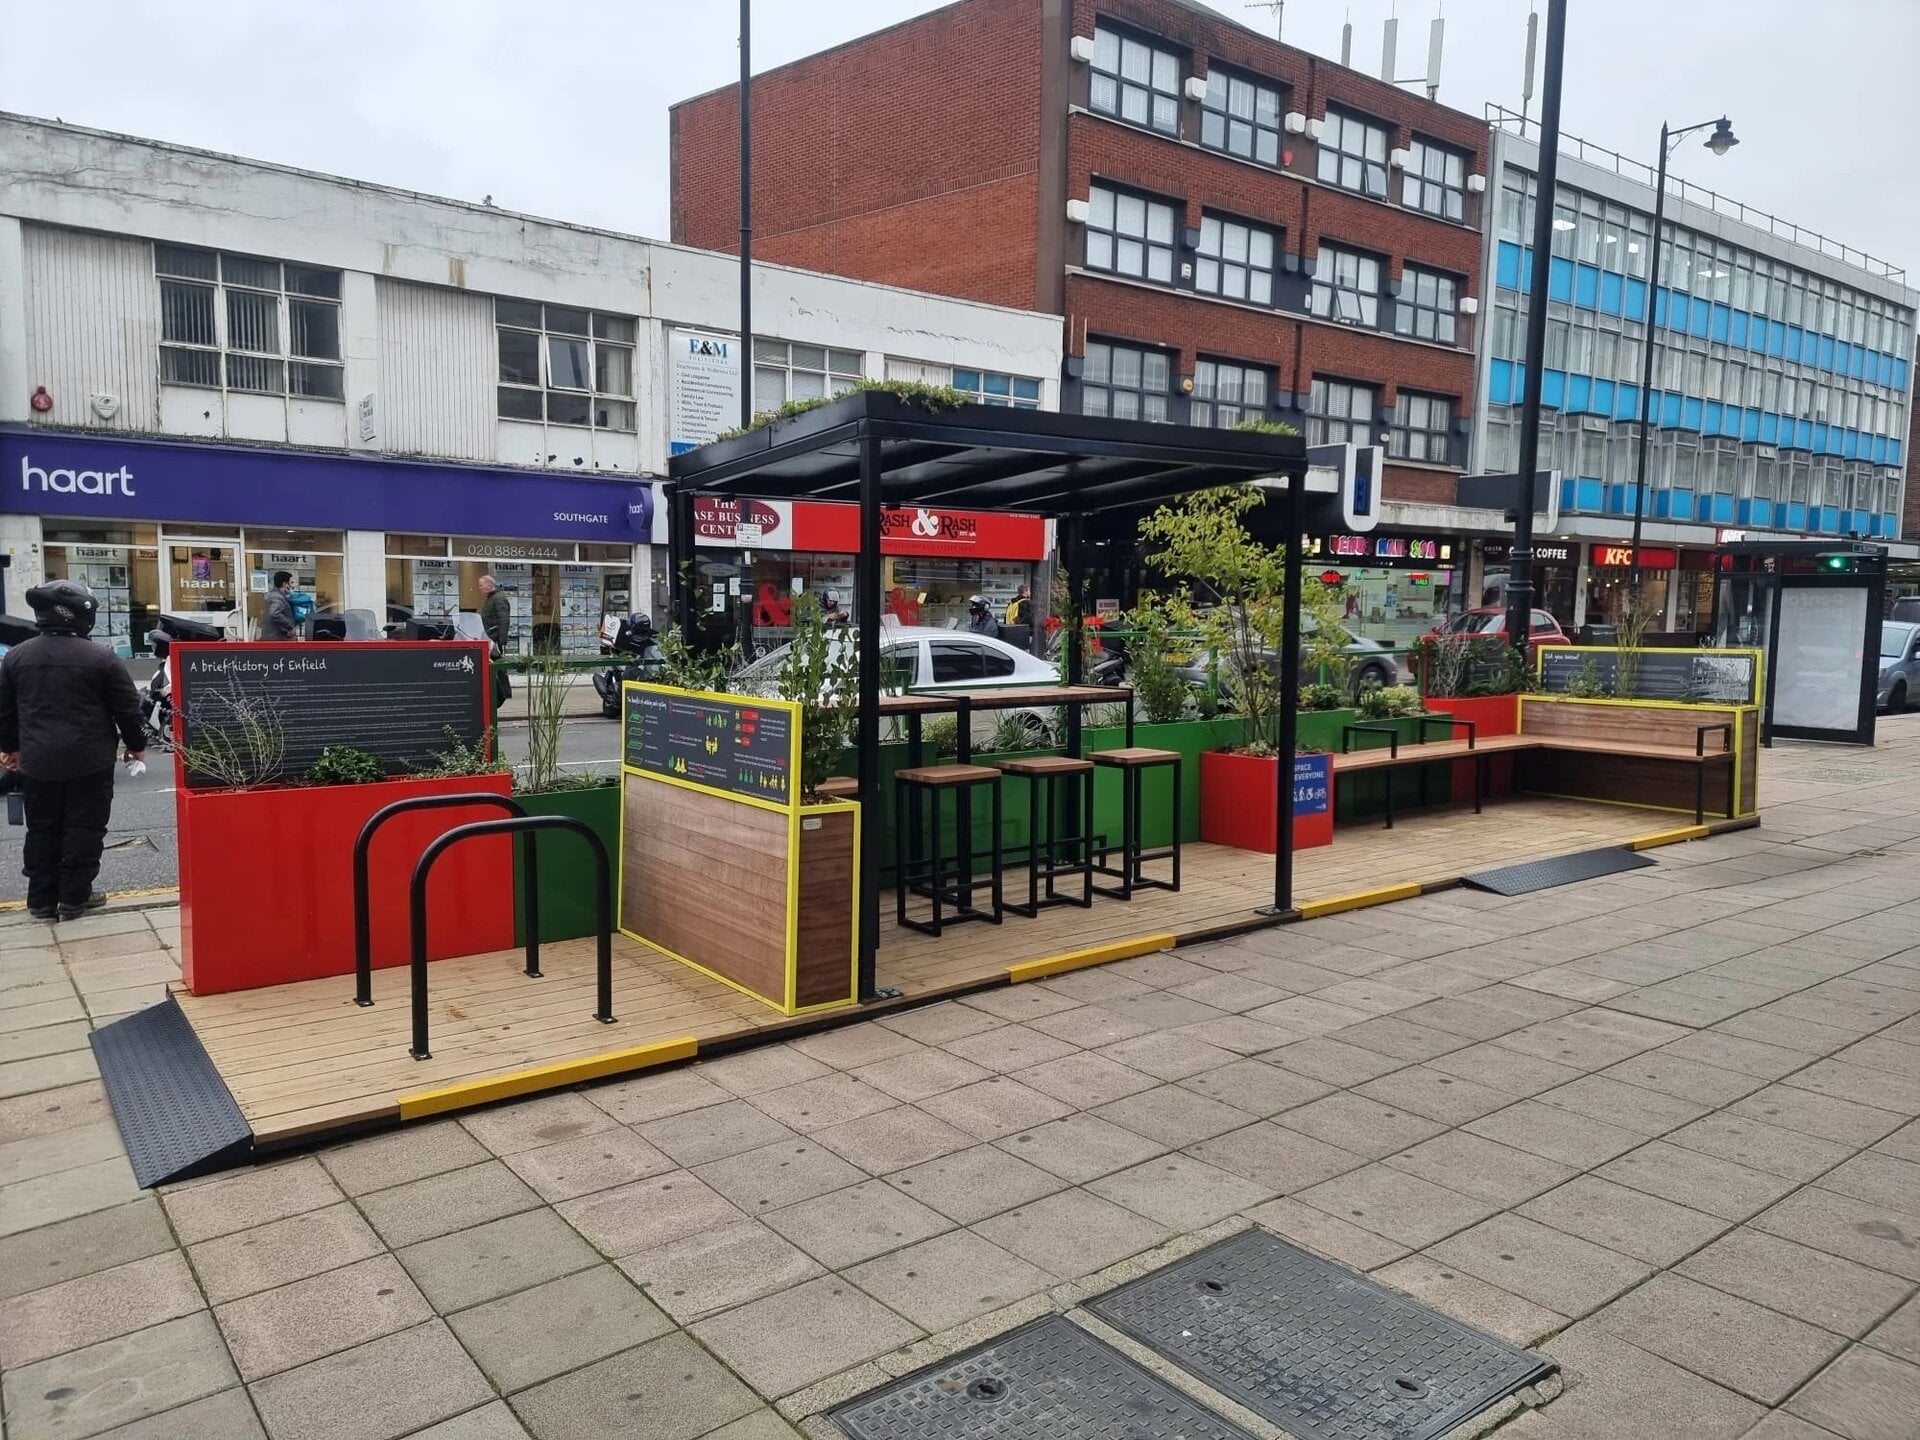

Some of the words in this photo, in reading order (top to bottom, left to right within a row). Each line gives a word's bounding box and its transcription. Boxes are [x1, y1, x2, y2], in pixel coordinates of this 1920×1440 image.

[690, 338, 727, 358] E&M
[22, 456, 136, 496] haart
[628, 502, 644, 515] haart
[712, 498, 737, 510] THE
[553, 512, 609, 524] SOUTHGATE
[719, 512, 774, 524] BUSESS
[912, 508, 939, 536] &
[940, 515, 976, 538] RASH
[700, 524, 736, 535] CENT
[76, 546, 118, 558] haart
[468, 544, 492, 556] 020
[494, 545, 526, 557] 8886
[528, 547, 558, 558] 4444
[1536, 548, 1567, 559] COFFEE
[1605, 548, 1633, 566] KFC
[271, 552, 308, 564] haart
[419, 560, 452, 569] haart
[495, 562, 526, 572] haart
[565, 565, 594, 573] haart
[180, 577, 226, 589] haart
[190, 661, 198, 672] A
[202, 658, 230, 674] brief
[232, 658, 269, 676] history
[273, 659, 286, 674] of
[288, 658, 327, 672] Enfield
[1295, 771, 1324, 781] EVERYONE
